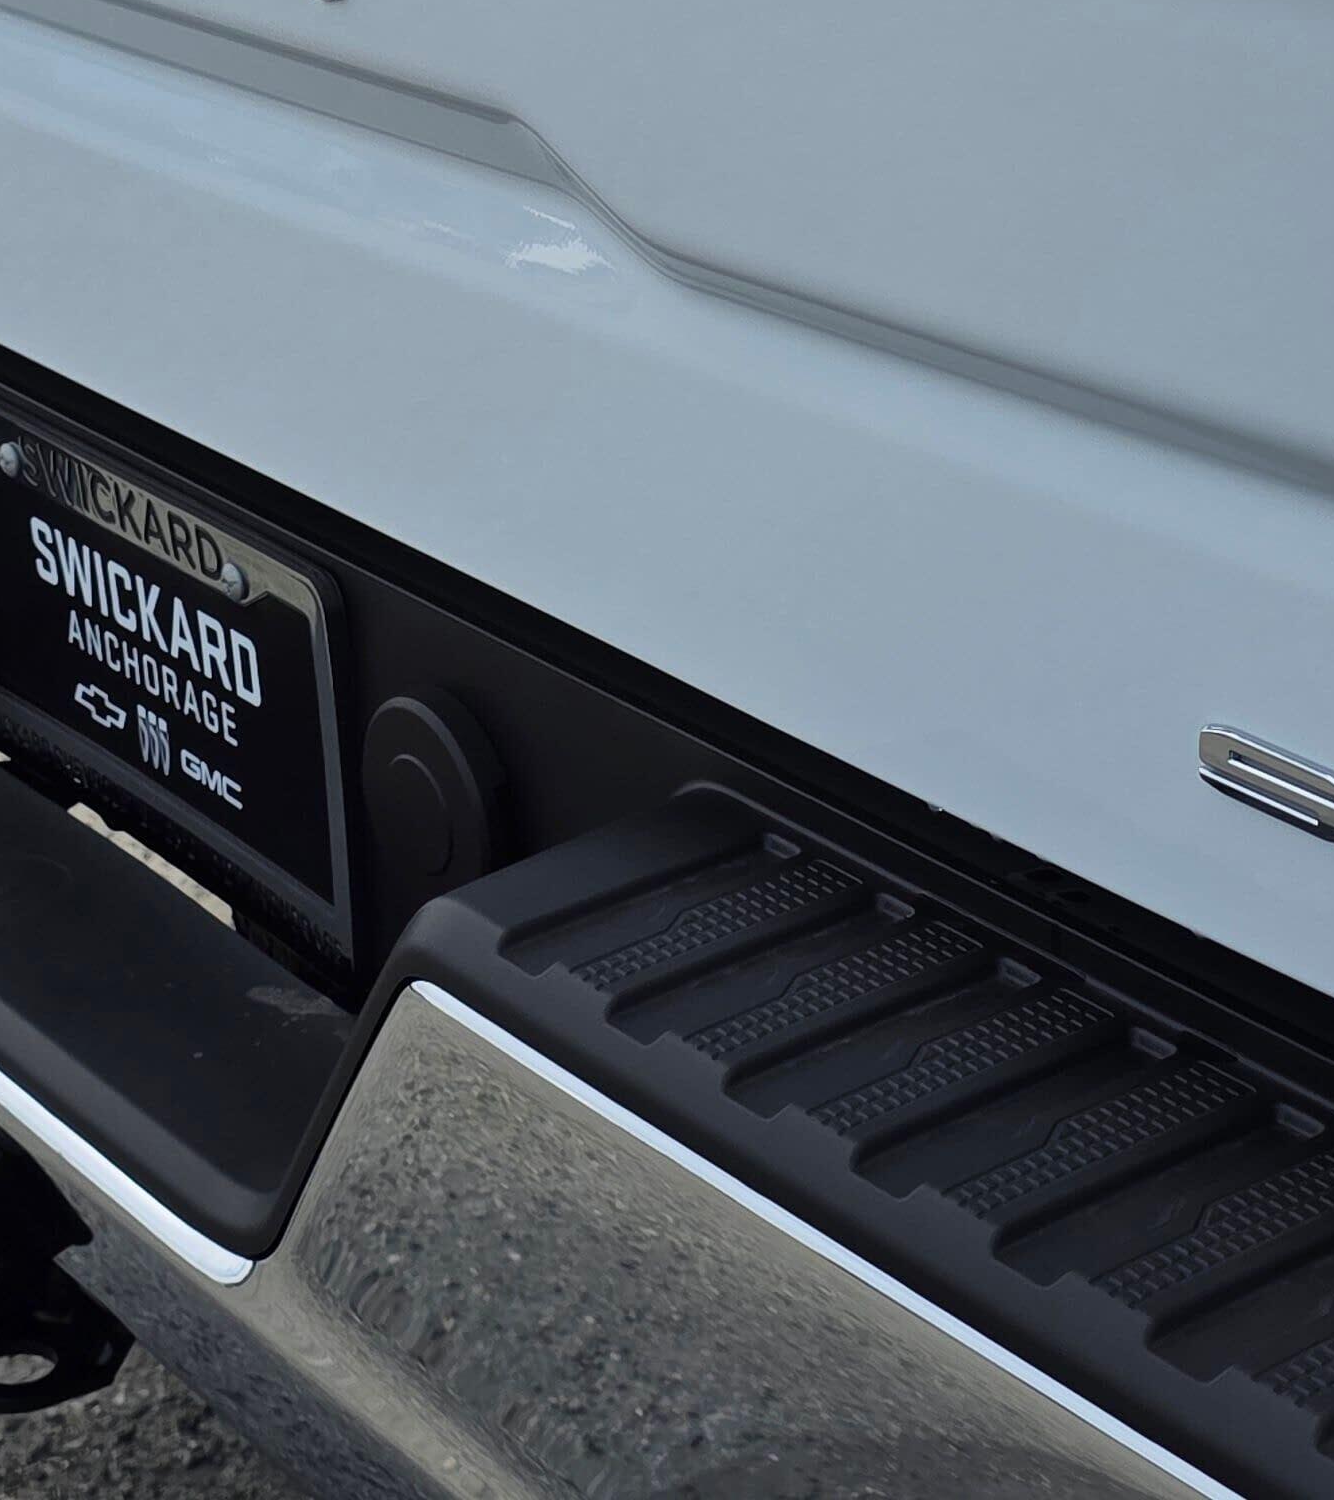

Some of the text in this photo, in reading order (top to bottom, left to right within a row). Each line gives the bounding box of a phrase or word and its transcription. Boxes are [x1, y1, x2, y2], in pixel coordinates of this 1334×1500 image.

[18, 436, 223, 581] SWICKARD
[29, 515, 262, 707] SWICKARD
[67, 609, 239, 748] ANCHORAGE
[180, 749, 243, 810] GMC
